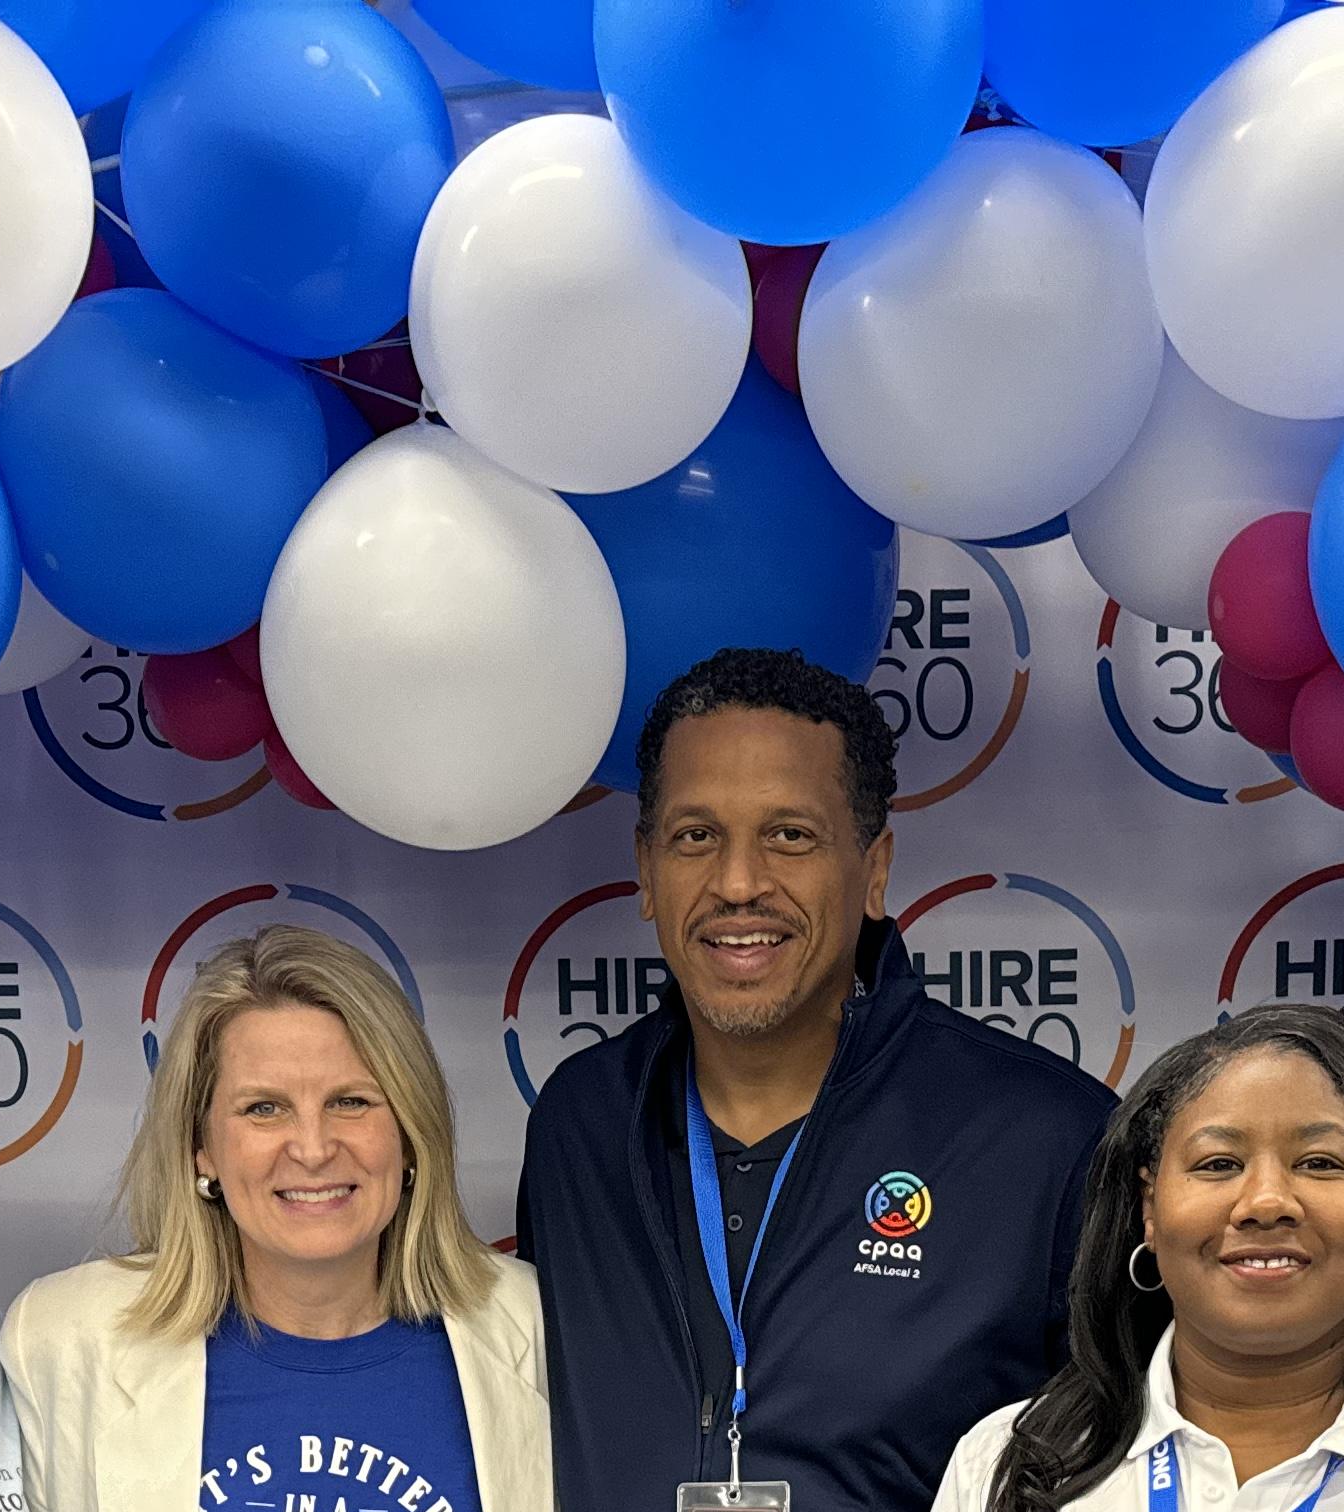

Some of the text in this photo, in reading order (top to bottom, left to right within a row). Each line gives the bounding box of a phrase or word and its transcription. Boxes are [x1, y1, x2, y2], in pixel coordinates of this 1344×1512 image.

[883, 588, 972, 650] RE
[870, 656, 974, 741] 60
[557, 957, 673, 1015] HIR
[912, 948, 1078, 1008] HIRE
[854, 1262, 921, 1279] AFSA Local 2
[859, 1239, 922, 1261] cpaa
[1153, 1440, 1171, 1491] DNC
